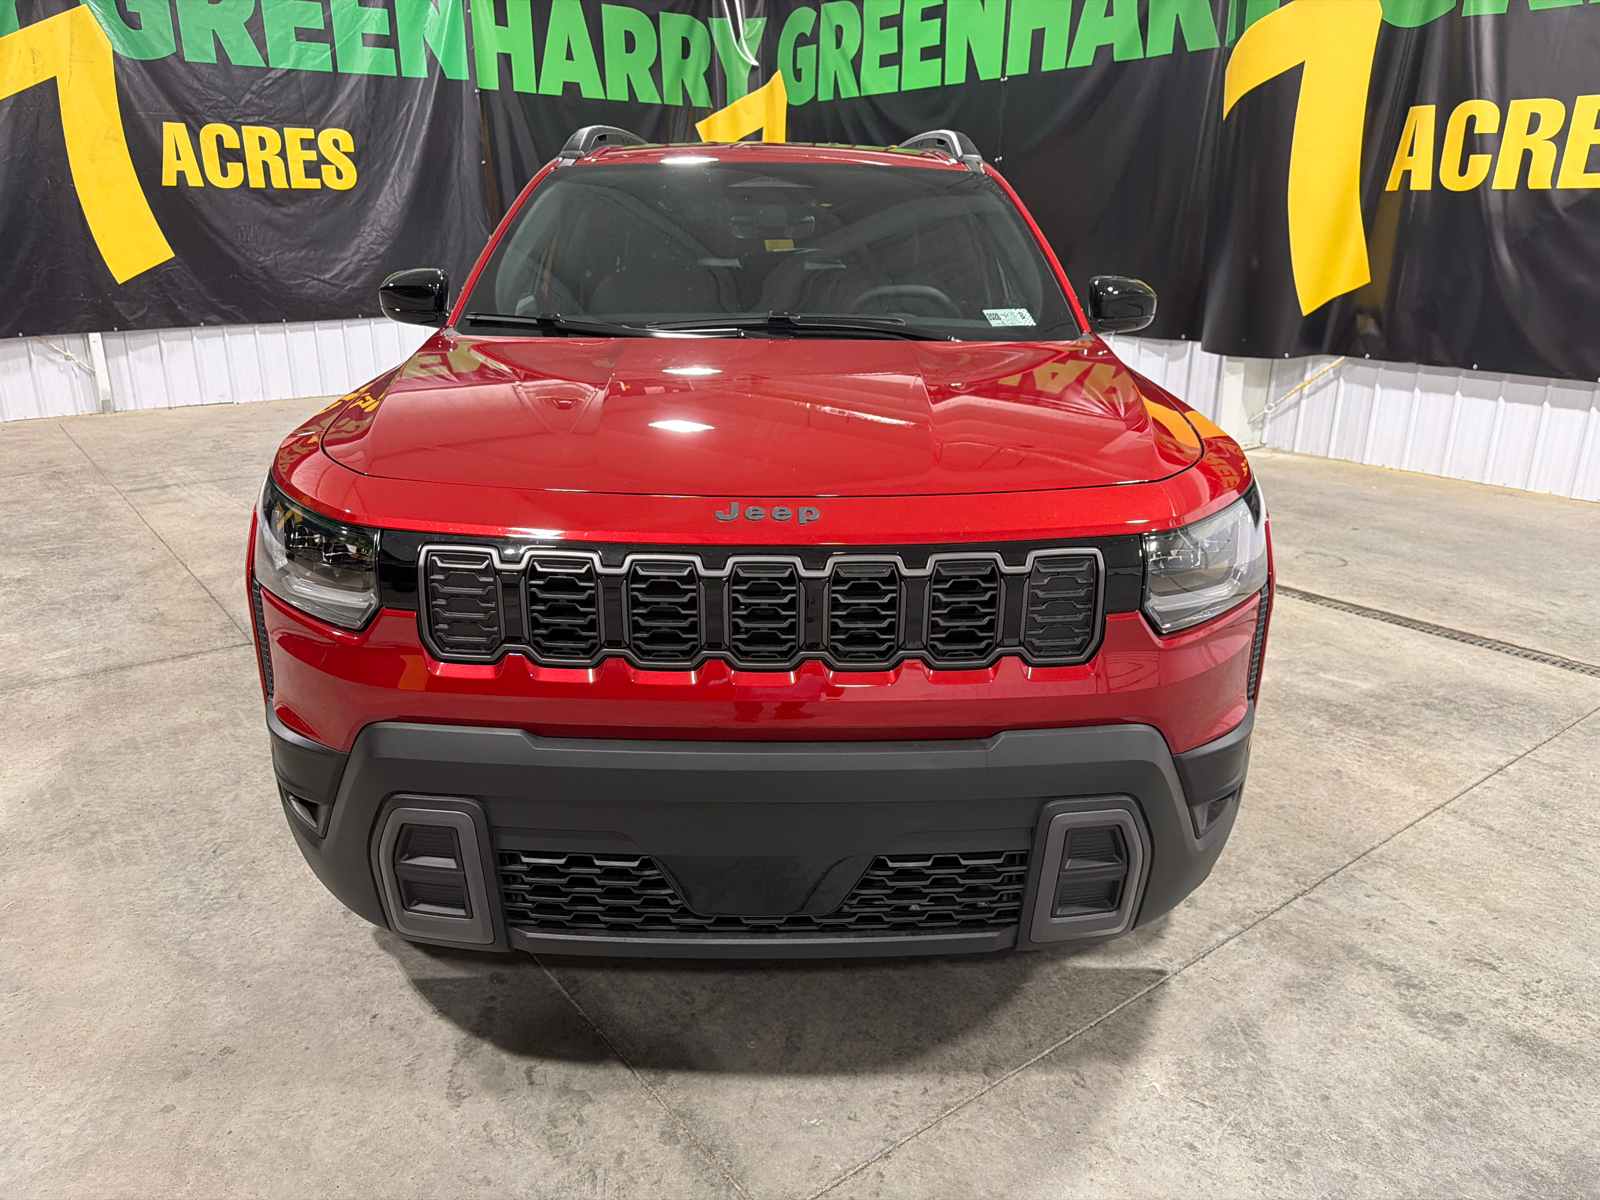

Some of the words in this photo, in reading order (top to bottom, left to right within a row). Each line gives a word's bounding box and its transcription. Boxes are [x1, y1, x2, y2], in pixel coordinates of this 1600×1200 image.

[469, 0, 767, 109] HARRY
[777, 0, 1006, 107] GREEN
[161, 121, 358, 191] ACRES
[1222, 0, 1372, 317] 7
[715, 502, 820, 525] Jeep
